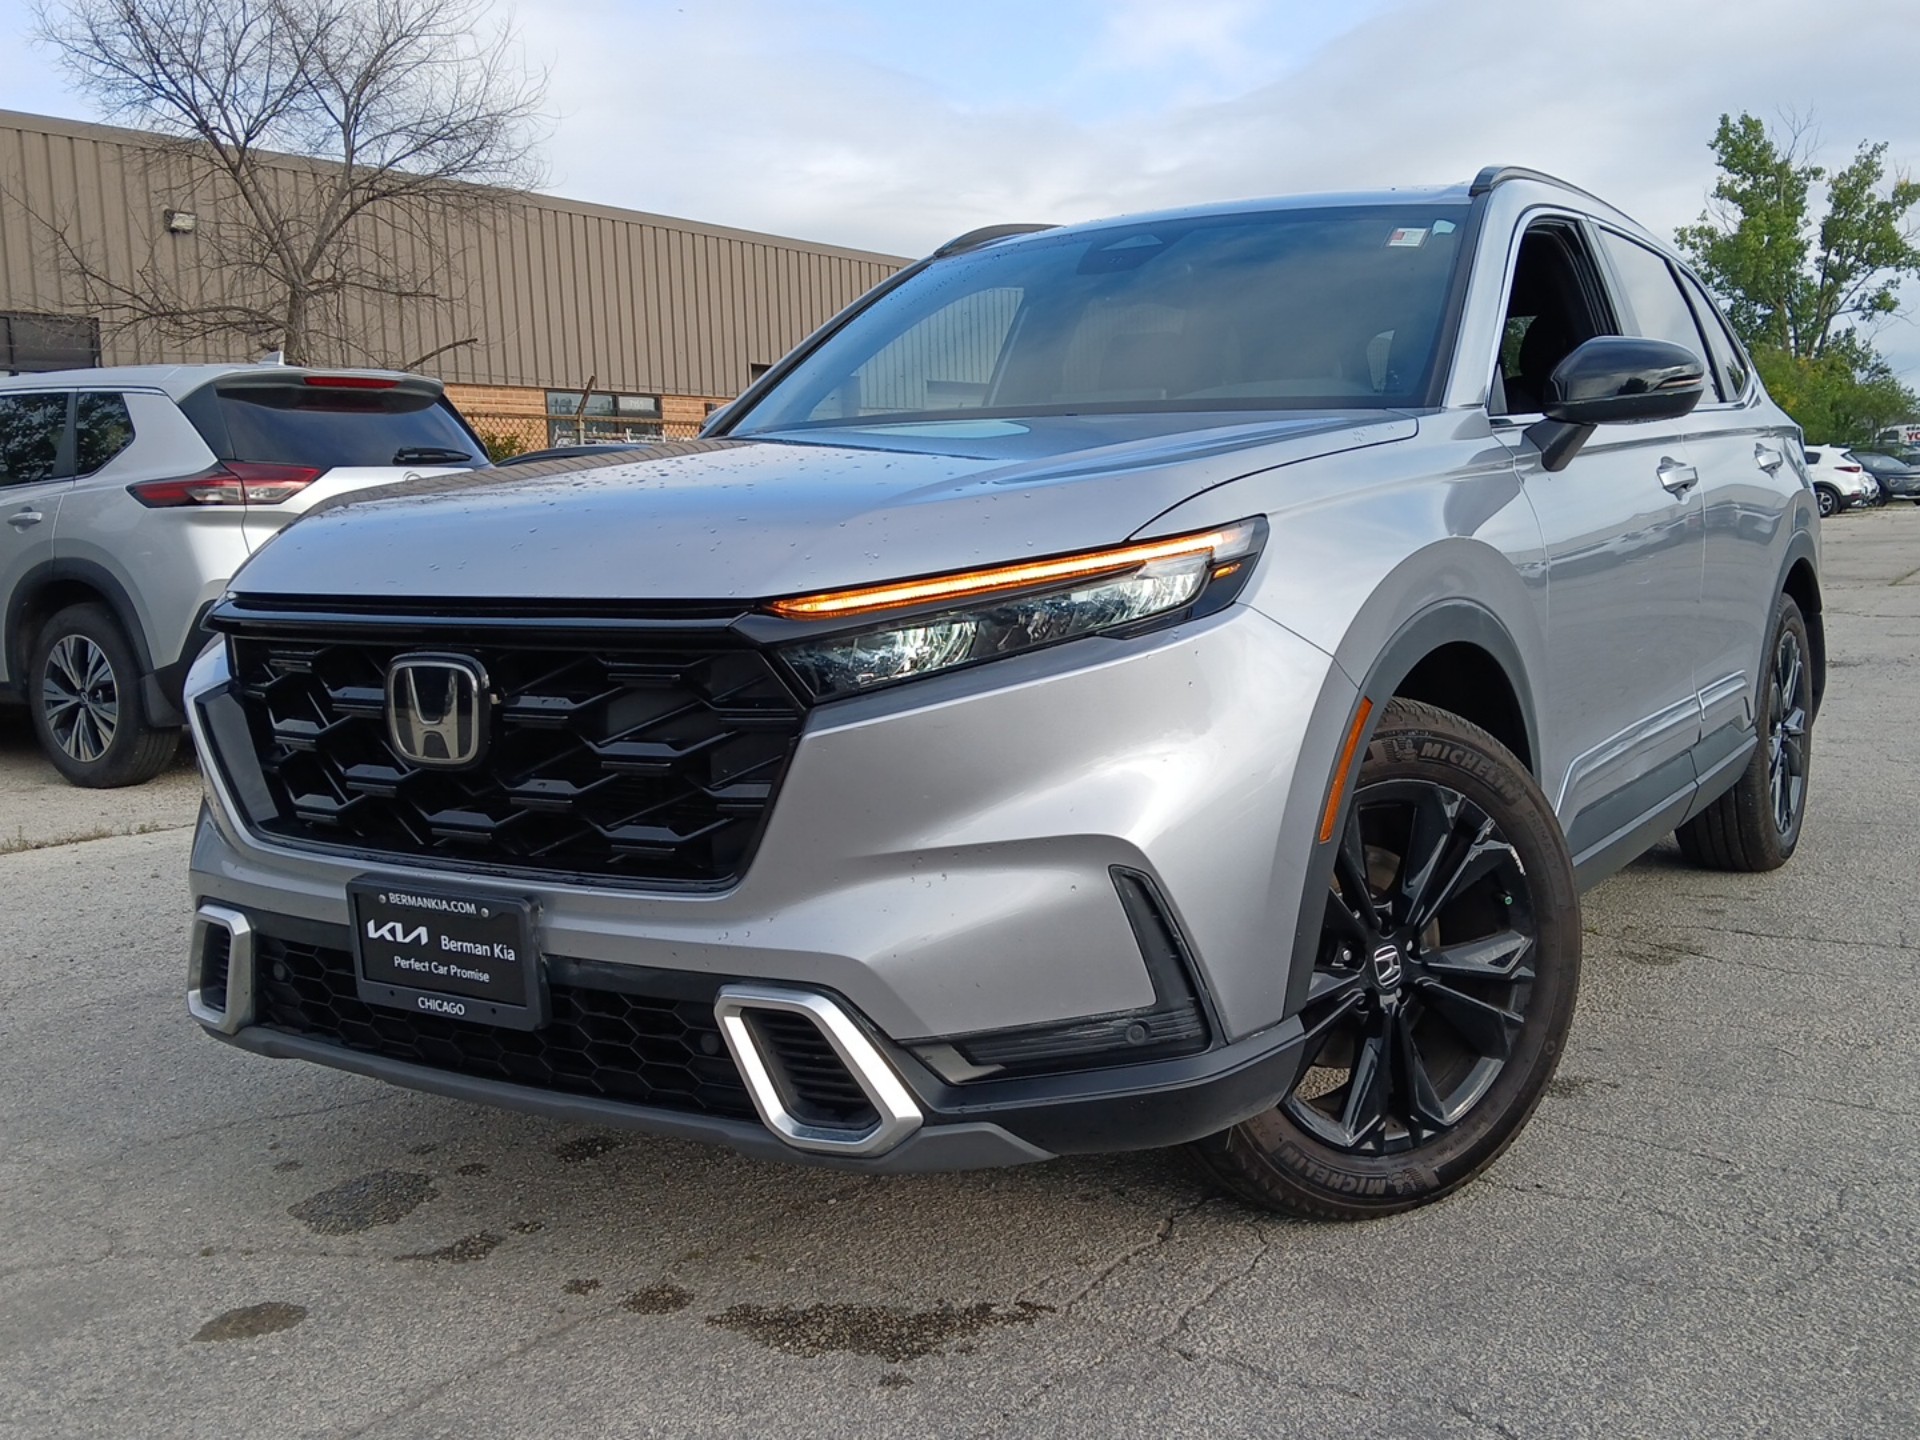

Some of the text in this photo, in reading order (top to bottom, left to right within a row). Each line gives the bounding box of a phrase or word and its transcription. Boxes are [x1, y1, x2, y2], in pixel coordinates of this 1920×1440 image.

[1420, 742, 1520, 800] MICHELIN
[388, 892, 477, 915] BERMANKIA.COM
[367, 919, 429, 946] KIA
[440, 935, 516, 961] Berman Kia
[393, 955, 490, 983] Perfect Car Promise
[417, 996, 465, 1016] CHICAGO
[1279, 1146, 1386, 1195] MICHELIN
